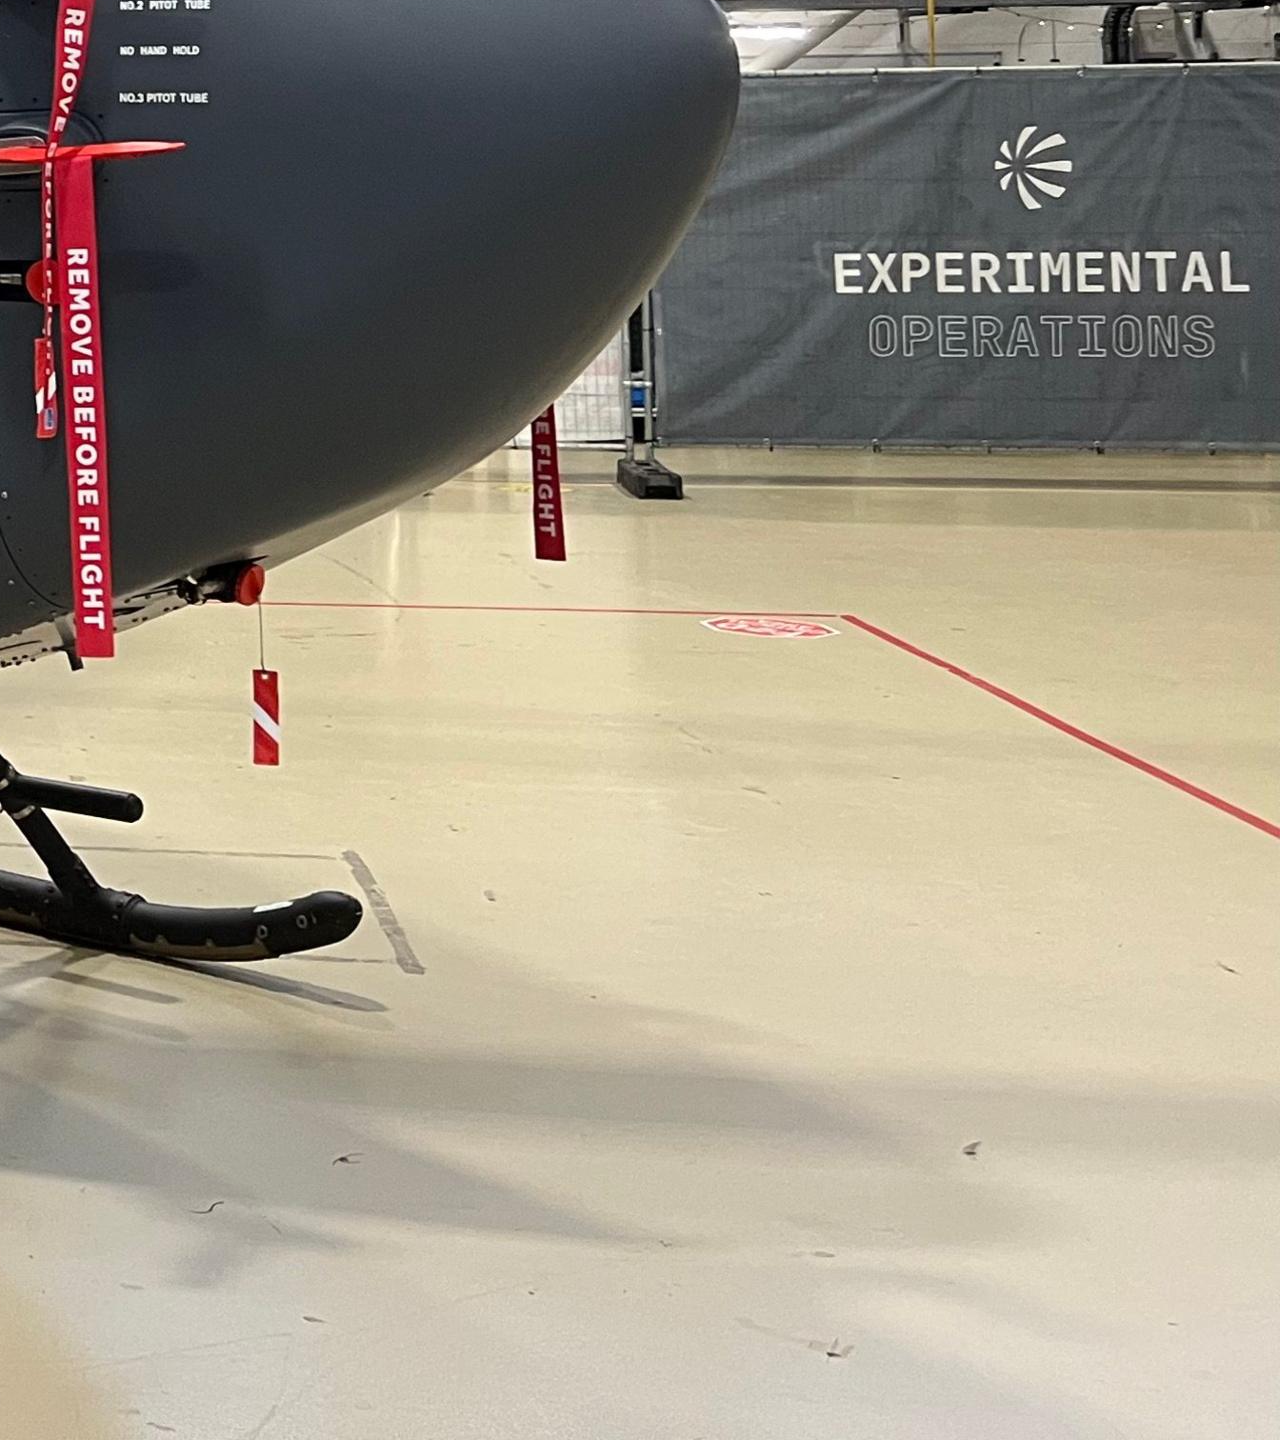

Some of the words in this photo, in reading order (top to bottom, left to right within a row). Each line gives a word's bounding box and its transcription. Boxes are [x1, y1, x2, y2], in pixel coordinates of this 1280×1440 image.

[119, 0, 145, 11] NO.2
[149, 0, 178, 10] PITOT
[184, 0, 211, 10] TUBE
[53, 8, 87, 133] REMOVE
[119, 46, 136, 56] NO
[140, 45, 168, 56] HAND
[172, 45, 200, 56] HOLD
[119, 92, 144, 103] NO.3
[146, 92, 177, 103] PITOT
[179, 92, 209, 103] TUBE
[833, 250, 1251, 294] EXPERIMENTAL
[66, 247, 95, 377] REMOVE
[868, 314, 1216, 359] OPERATIONS
[73, 386, 100, 507] BEFORE
[535, 444, 557, 537] FLIGHT
[77, 516, 106, 630] FLIGHT
